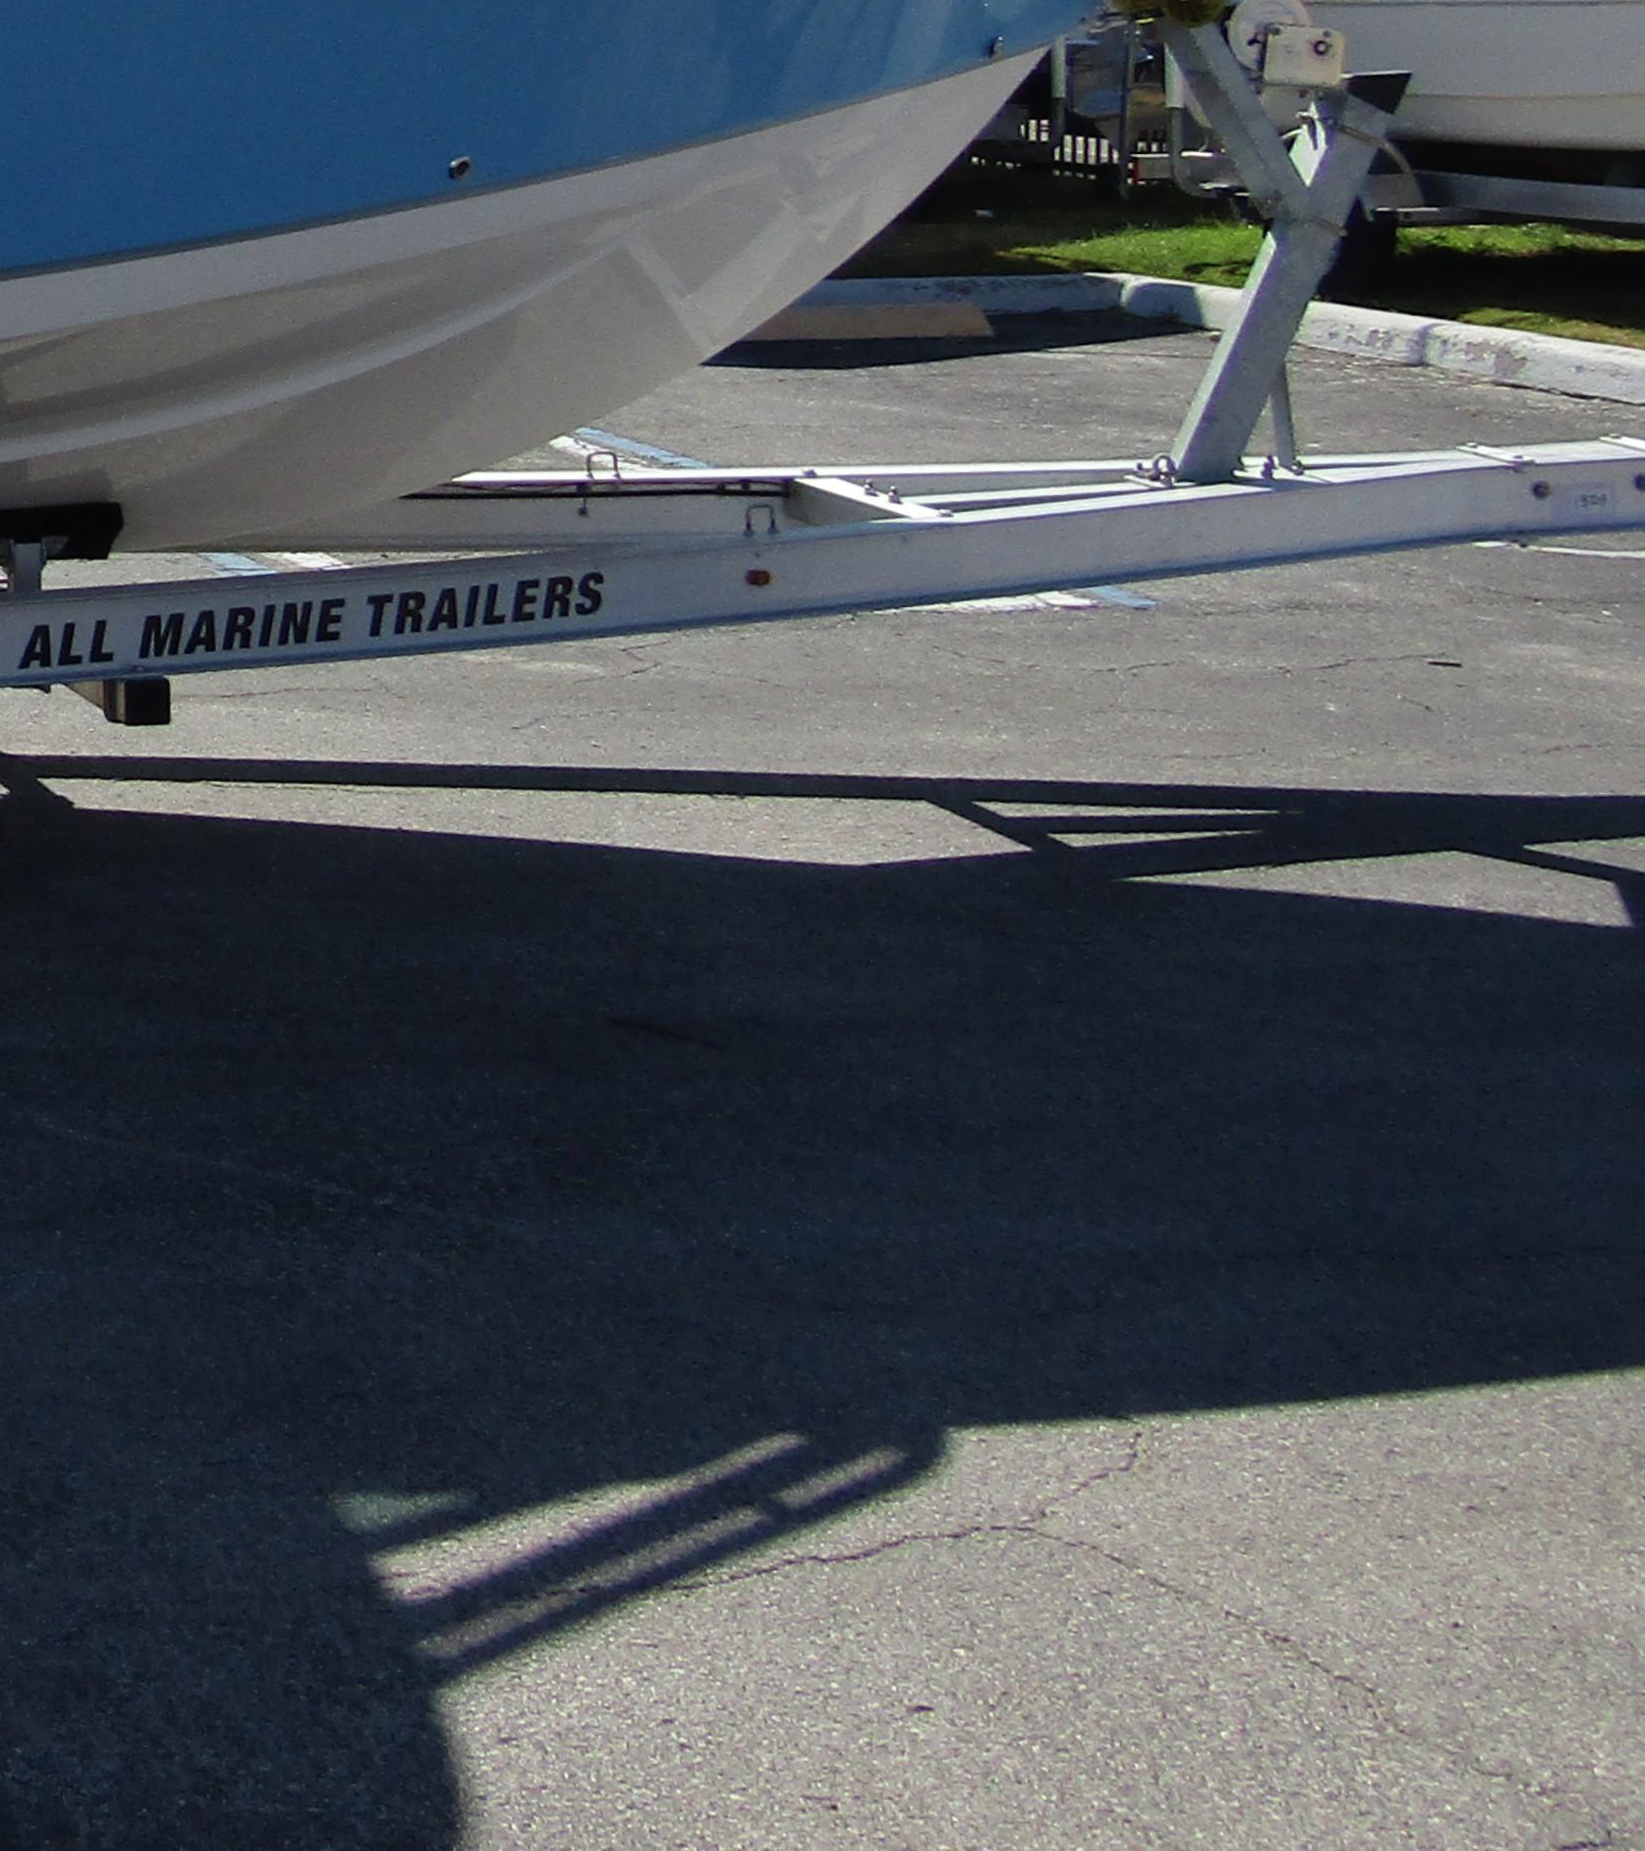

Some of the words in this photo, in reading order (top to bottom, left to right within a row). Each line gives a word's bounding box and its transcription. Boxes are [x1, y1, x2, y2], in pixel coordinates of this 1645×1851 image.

[17, 622, 115, 670] ALL
[138, 597, 346, 660] MARINE
[366, 570, 605, 638] TRAILERS
